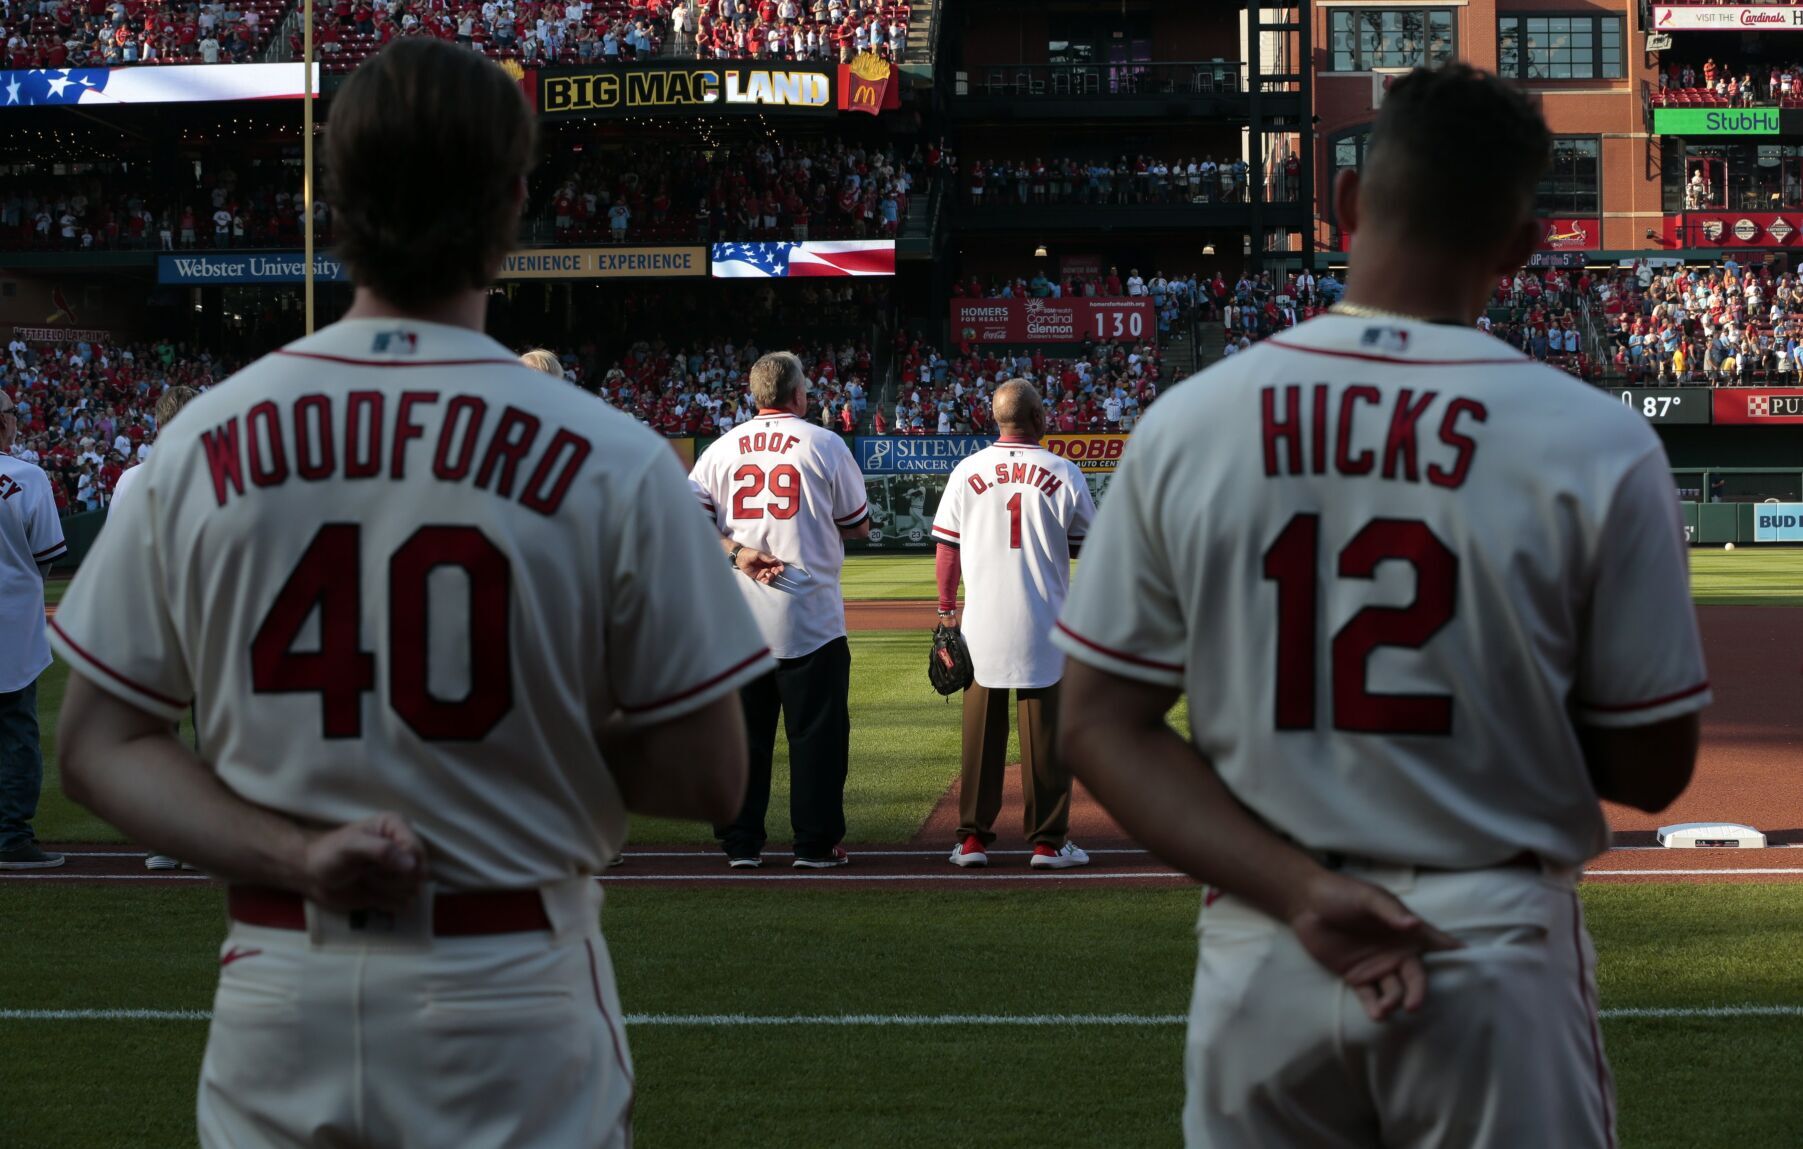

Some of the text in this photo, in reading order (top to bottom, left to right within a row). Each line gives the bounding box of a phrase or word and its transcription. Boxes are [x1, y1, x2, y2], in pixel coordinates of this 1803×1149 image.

[1696, 13, 1717, 22] VISIT
[1719, 13, 1735, 22] THE
[1740, 9, 1786, 26] Cardinals
[545, 70, 830, 112] BIG MAC LAND
[1706, 112, 1779, 131] StubHu
[174, 258, 245, 278] Webster
[599, 252, 692, 271] EXPERIENCE
[1527, 253, 1542, 266] OP
[961, 307, 1009, 316] HOMERS
[1027, 314, 1073, 324] Cardinal
[1027, 324, 1073, 334] Glennon
[1643, 396, 1681, 417] 87°
[738, 431, 801, 455] ROOF
[1260, 383, 1489, 491] HICKS
[201, 390, 593, 518] WOODFORD
[1047, 439, 1127, 459] DOBB
[897, 459, 949, 470] CANCER
[1076, 460, 1098, 468] AUTO
[967, 462, 1063, 498] O. SMITH
[733, 463, 801, 520] 29
[1006, 492, 1022, 549] 1
[1759, 515, 1797, 529] BUD
[871, 531, 881, 539] 20
[911, 530, 921, 539] 23
[250, 521, 516, 743] 40
[1262, 511, 1461, 737] 12
